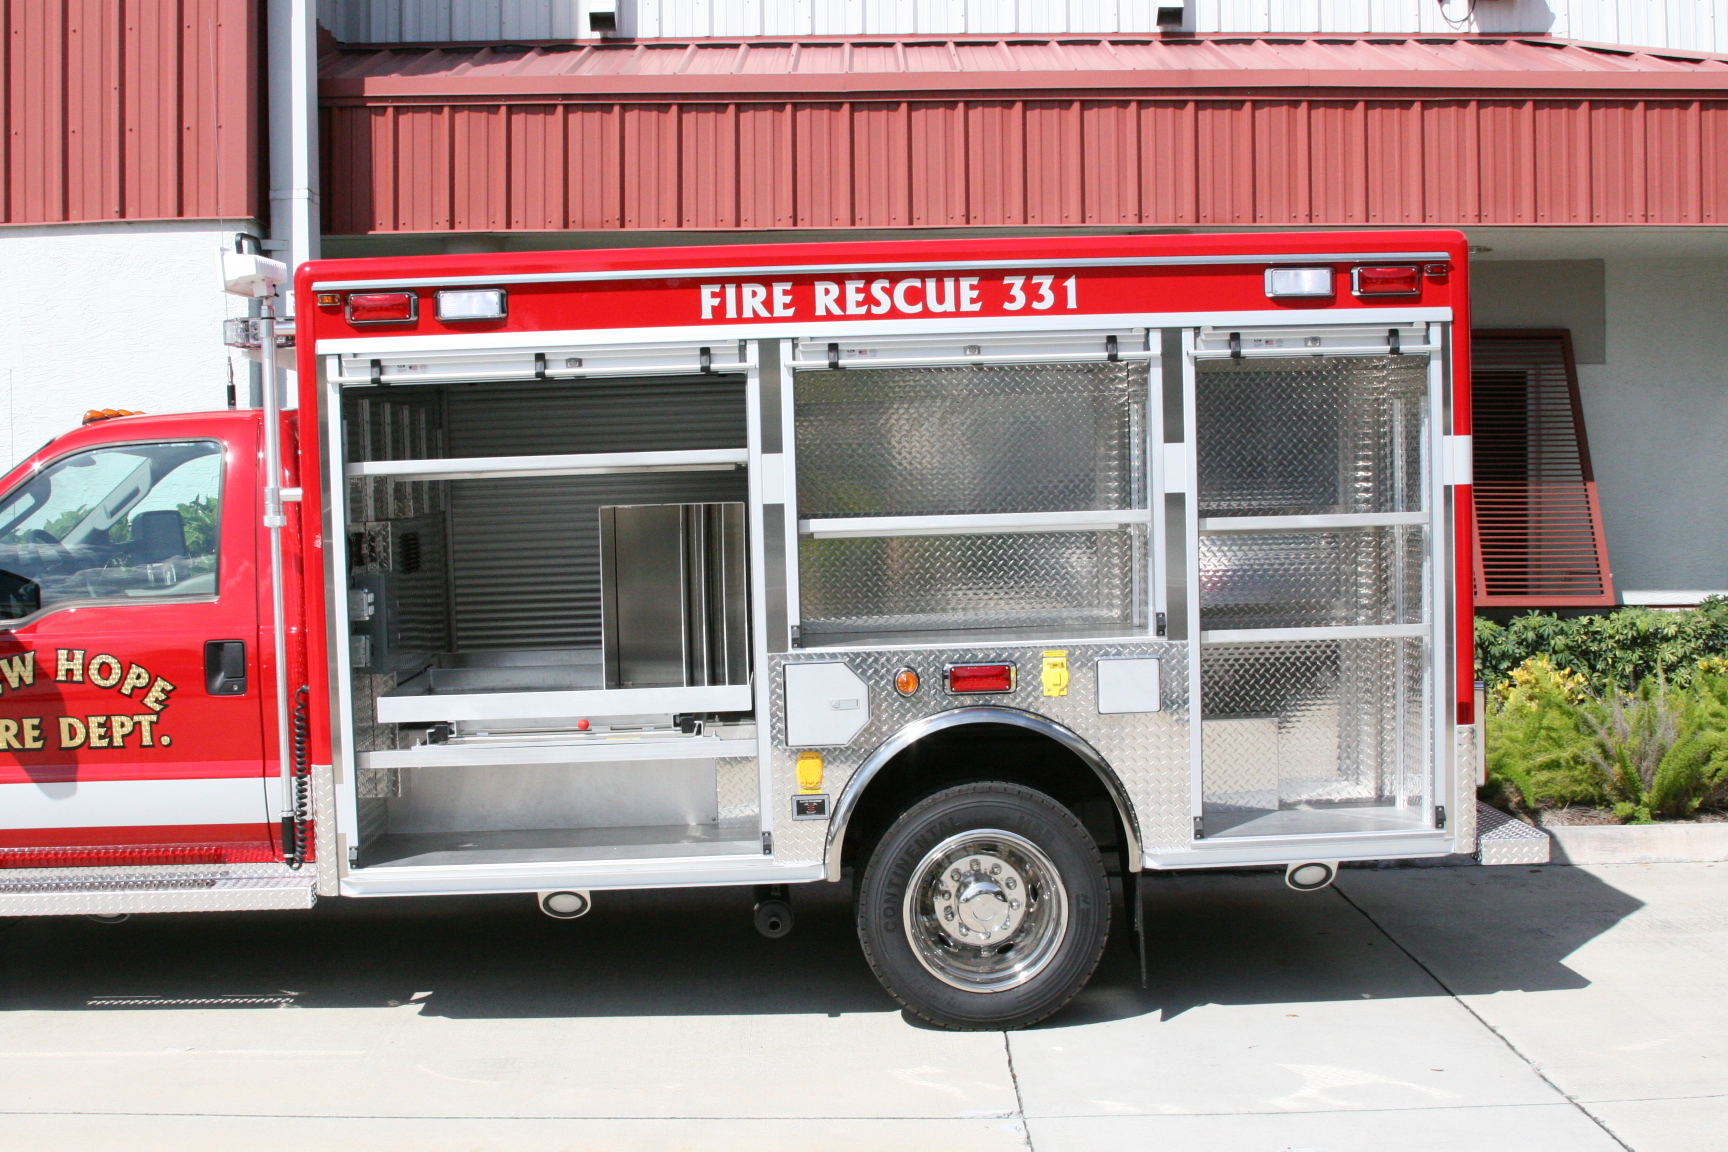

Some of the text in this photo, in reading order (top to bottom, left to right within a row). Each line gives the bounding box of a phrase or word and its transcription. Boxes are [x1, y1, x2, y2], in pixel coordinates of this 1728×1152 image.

[701, 274, 1078, 319] FIRE RESCUE 331
[55, 648, 177, 712] HOPE
[58, 713, 172, 749] DEPT.
[882, 816, 962, 934] CONTINENTAL
